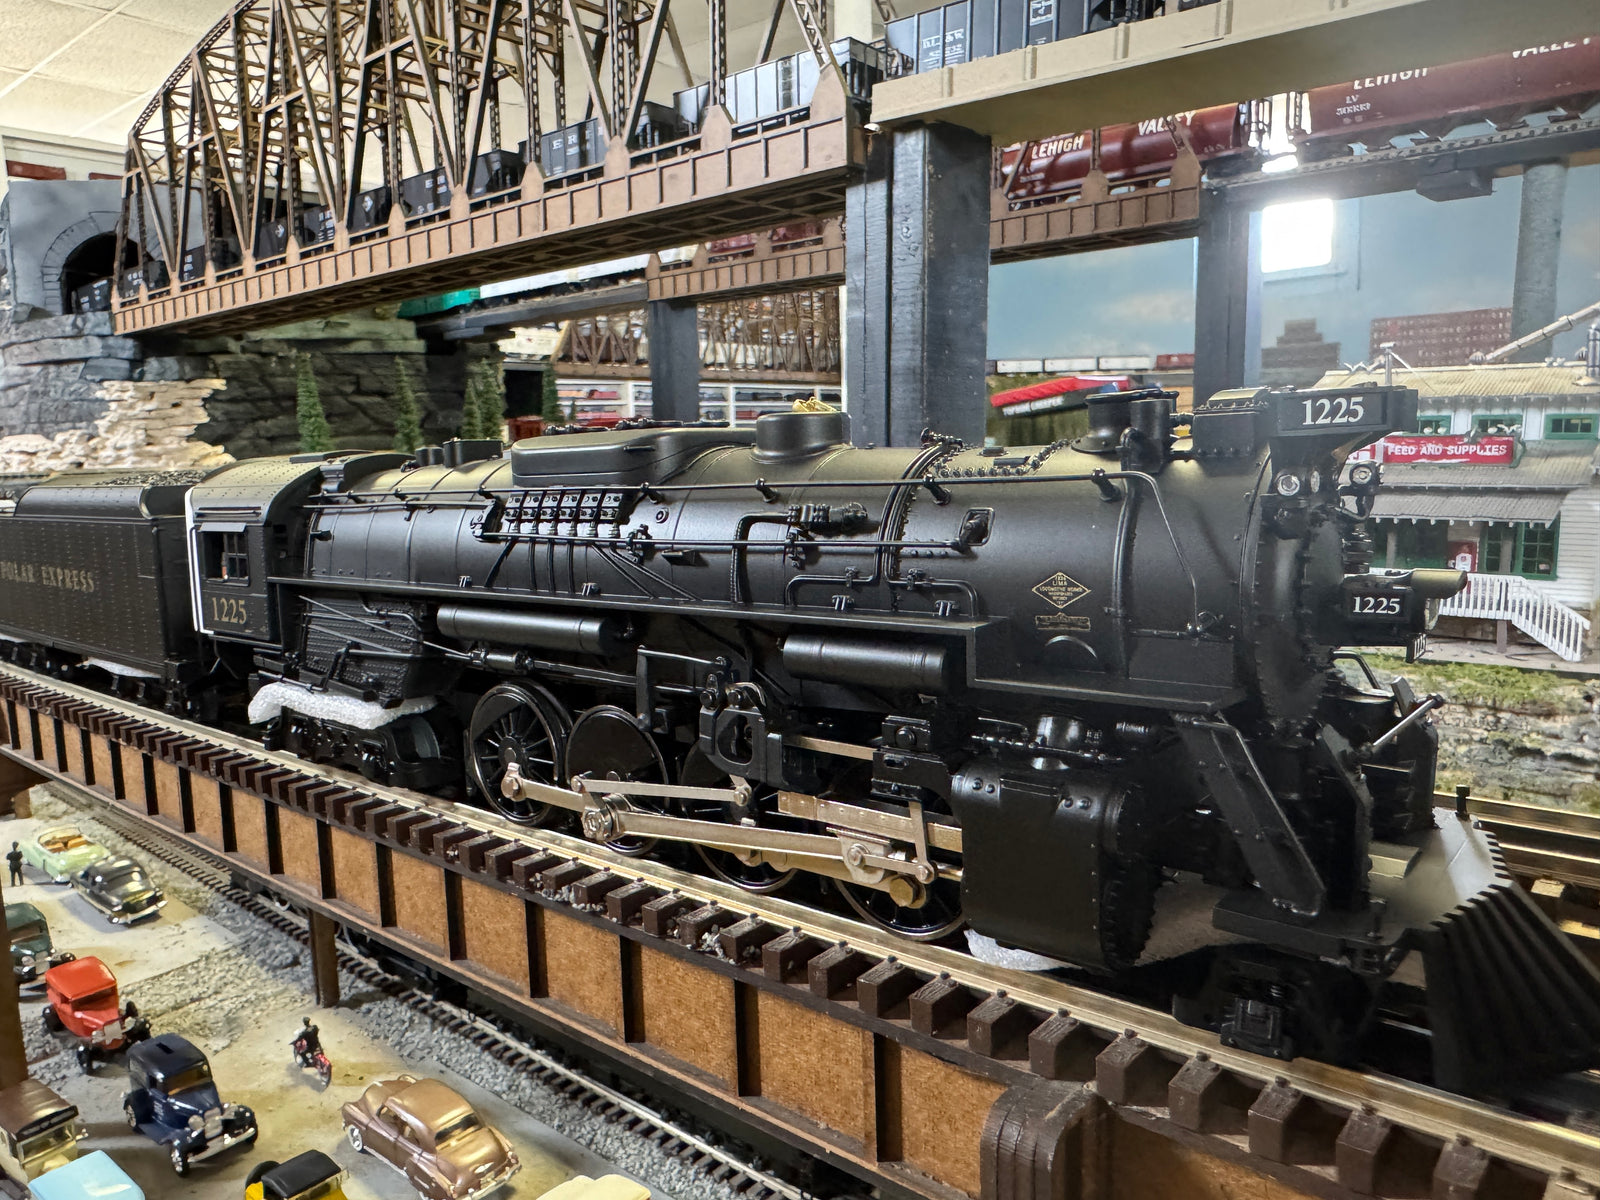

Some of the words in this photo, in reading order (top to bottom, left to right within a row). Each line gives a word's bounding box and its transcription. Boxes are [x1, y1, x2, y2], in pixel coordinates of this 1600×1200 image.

[1031, 135, 1085, 159] LEHIGH
[1302, 397, 1364, 425] 1225
[1387, 443, 1416, 456] FEED
[1419, 443, 1443, 456] AND
[1447, 444, 1507, 456] SUPPLIES
[41, 565, 94, 593] EXPRESS
[212, 597, 248, 625] 1225
[1352, 596, 1401, 614] 1225
